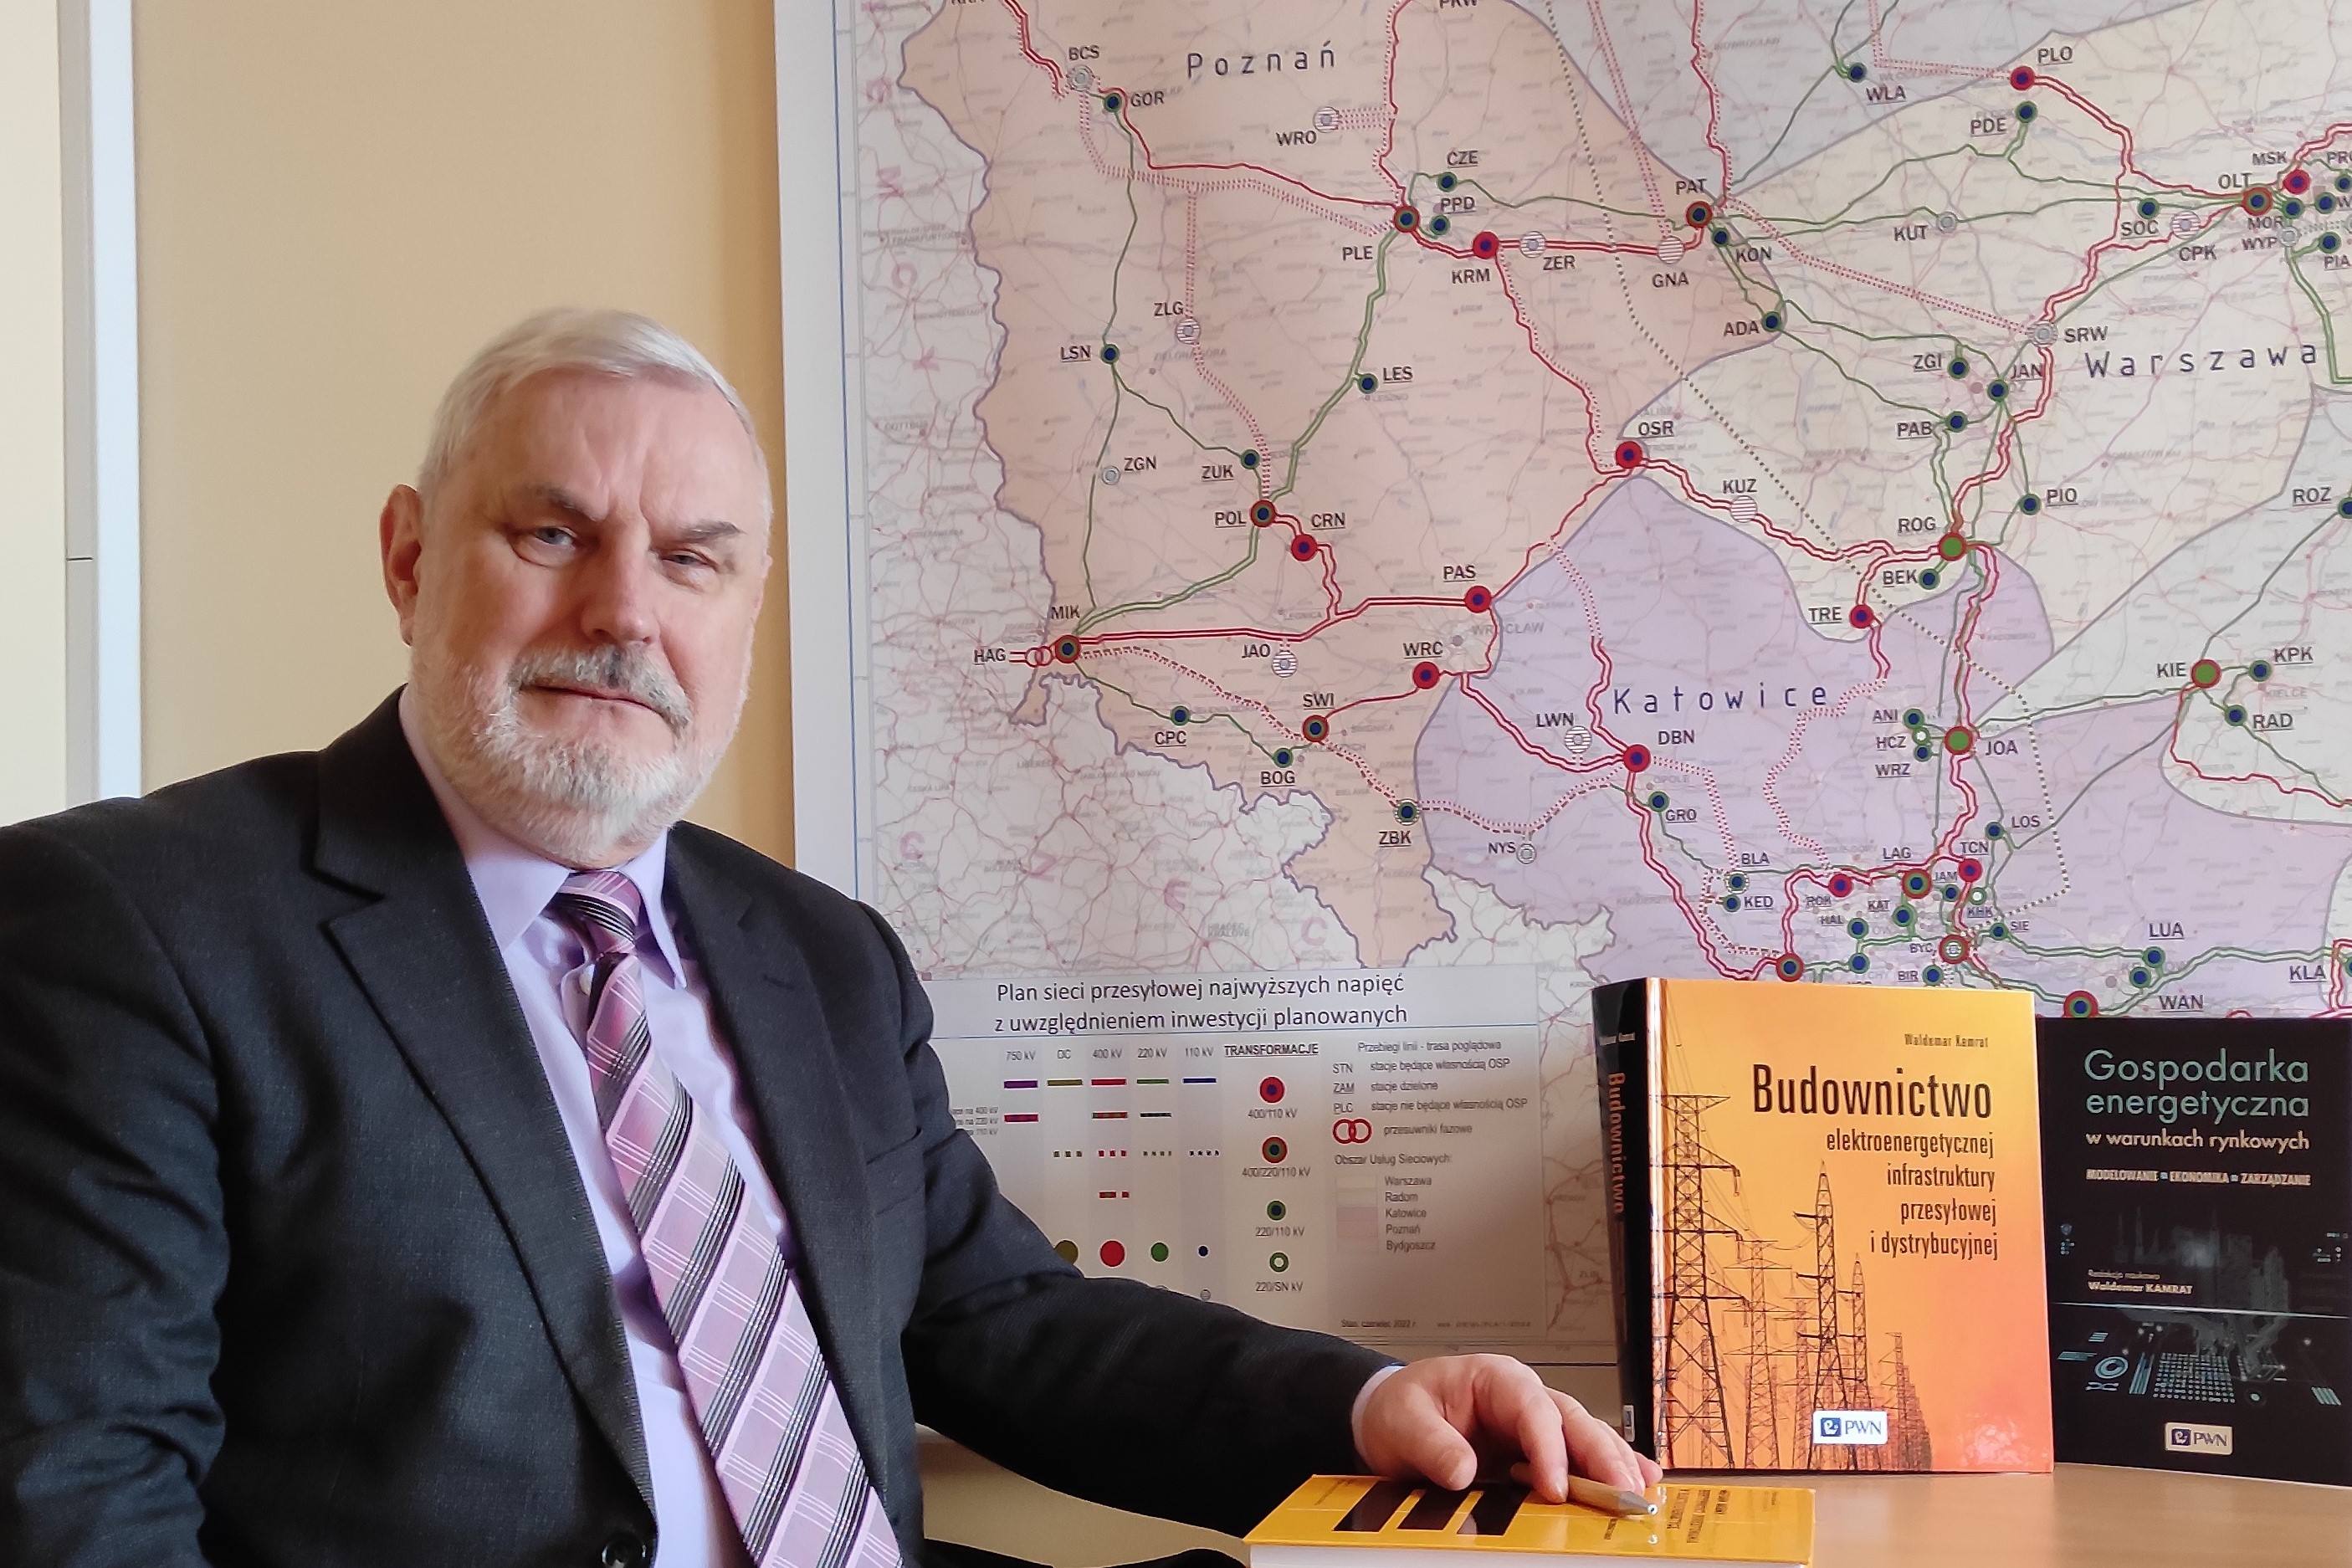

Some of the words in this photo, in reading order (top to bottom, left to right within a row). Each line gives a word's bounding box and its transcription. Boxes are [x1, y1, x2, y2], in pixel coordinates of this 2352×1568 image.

[1068, 46, 1099, 59] BCS
[1187, 40, 1335, 79] Poznań
[2037, 47, 2073, 64] PLO
[1130, 91, 1164, 107] GOR
[1866, 87, 1905, 102] WLA
[1970, 119, 2006, 135] PDE
[1277, 131, 1316, 146] WRO
[1447, 151, 1478, 166] CZE
[2252, 151, 2288, 166] MSK
[2327, 151, 2352, 164] PR
[1676, 179, 1707, 194] PAT
[2218, 173, 2251, 188] OLT
[1440, 197, 1474, 213] PPD
[1893, 226, 1928, 241] KUT
[2122, 222, 2160, 236] SOC
[1342, 247, 1372, 261] PLE
[1736, 247, 1772, 262] KON
[2179, 246, 2216, 262] CPK
[1543, 256, 1575, 270] ZER
[2324, 255, 2350, 269] PIA
[1452, 269, 1490, 284] KRM
[1652, 273, 1688, 288] GNA
[1154, 302, 1184, 316] ZLG
[1724, 321, 1759, 336] ADA
[2064, 326, 2108, 343] SRW
[1061, 346, 1091, 360] LSN
[2085, 344, 2318, 379] Warszawa
[1383, 366, 1412, 381] LES
[2011, 363, 2043, 379] JAN
[1638, 421, 1673, 436] OSR
[1898, 423, 1932, 437] PAB
[1125, 457, 1156, 471] ZGN
[1202, 465, 1233, 479] ZUK
[1723, 479, 1757, 494] KUZ
[2047, 489, 2078, 504] PIO
[2293, 488, 2331, 504] ROZ
[1215, 512, 1247, 525] POL
[1311, 513, 1345, 527] CRN
[1899, 517, 1936, 532] ROG
[1443, 566, 1475, 580] PAS
[1883, 571, 1916, 585] BEK
[1051, 605, 1080, 619] MIK
[1809, 607, 1841, 622] TRE
[974, 648, 1005, 664] HAG
[1403, 642, 1443, 657] WRC
[2274, 648, 2314, 663] KPK
[2157, 663, 2186, 678] KIE
[1303, 694, 1335, 708] SWI
[1614, 682, 1827, 715] Katowice
[1535, 713, 1574, 727] LWN
[1873, 710, 1899, 721] ANI
[2252, 714, 2293, 730] RAD
[1155, 731, 1186, 746] CPC
[1658, 730, 1695, 746] DBN
[1876, 736, 1906, 749] HCZ
[1986, 740, 2017, 756] JOA
[1876, 763, 1910, 776] WRZ
[1261, 771, 1295, 785] BOG
[1665, 808, 1697, 822] GRO
[2011, 816, 2040, 829] LOS
[1379, 831, 1412, 845] ZBK
[1488, 841, 1516, 854] NYS
[1883, 847, 1912, 859] LAG
[1960, 841, 1989, 853] TCN
[1741, 853, 1770, 865] BLA
[1744, 896, 1774, 908] KED
[1868, 899, 1889, 910] KAT
[2149, 922, 2184, 937] LUA
[1898, 971, 1919, 981] BIR
[2289, 965, 2326, 980] KLA
[997, 983, 1038, 1002] Plan
[1043, 981, 1085, 1001] sieci
[1091, 977, 1202, 1003] przesyłowej
[1209, 974, 1330, 1000] najwyższych
[1337, 972, 1405, 997] napięć
[2160, 995, 2203, 1010] WAN
[995, 1018, 1003, 1032] z
[1010, 1011, 1165, 1035] uwzględnieniem
[1171, 1007, 1268, 1031] inwestycji
[1273, 1005, 1407, 1028] planowanych
[1092, 1048, 1109, 1059] 400
[1137, 1048, 1153, 1058] 220
[1185, 1047, 1200, 1058] 110
[1224, 1043, 1319, 1056] TRANSFORMACJE
[1333, 1063, 1353, 1074] STN
[1489, 1058, 1510, 1069] OSP
[2084, 1047, 2309, 1090] Gospodarka
[1753, 1063, 1992, 1120] Budownictwo
[1506, 1098, 1528, 1109] OSP
[2086, 1090, 2309, 1125] energetyczna
[1608, 1073, 1627, 1213] Budownictwo
[1826, 1129, 1995, 1160] elektroenergetycznej
[2086, 1133, 2102, 1145] w
[2105, 1128, 2203, 1147] warunkach
[2209, 1130, 2309, 1154] rynkowych
[1385, 1176, 1432, 1186] Warszawa
[1887, 1164, 1996, 1192] infrastruktury
[1385, 1191, 1418, 1202] Radom
[1385, 1208, 1427, 1218] Katowice
[1900, 1198, 1997, 1227] przesyłowej
[1255, 1227, 1291, 1237] 220/110
[1386, 1223, 1421, 1234] Poznań
[1386, 1240, 1436, 1253] Bydgoszcz
[1870, 1231, 1876, 1253] i
[1881, 1231, 1999, 1261] dystrybucyjnej
[1845, 1419, 1882, 1436] PWN
[2193, 1432, 2227, 1447] PWN
